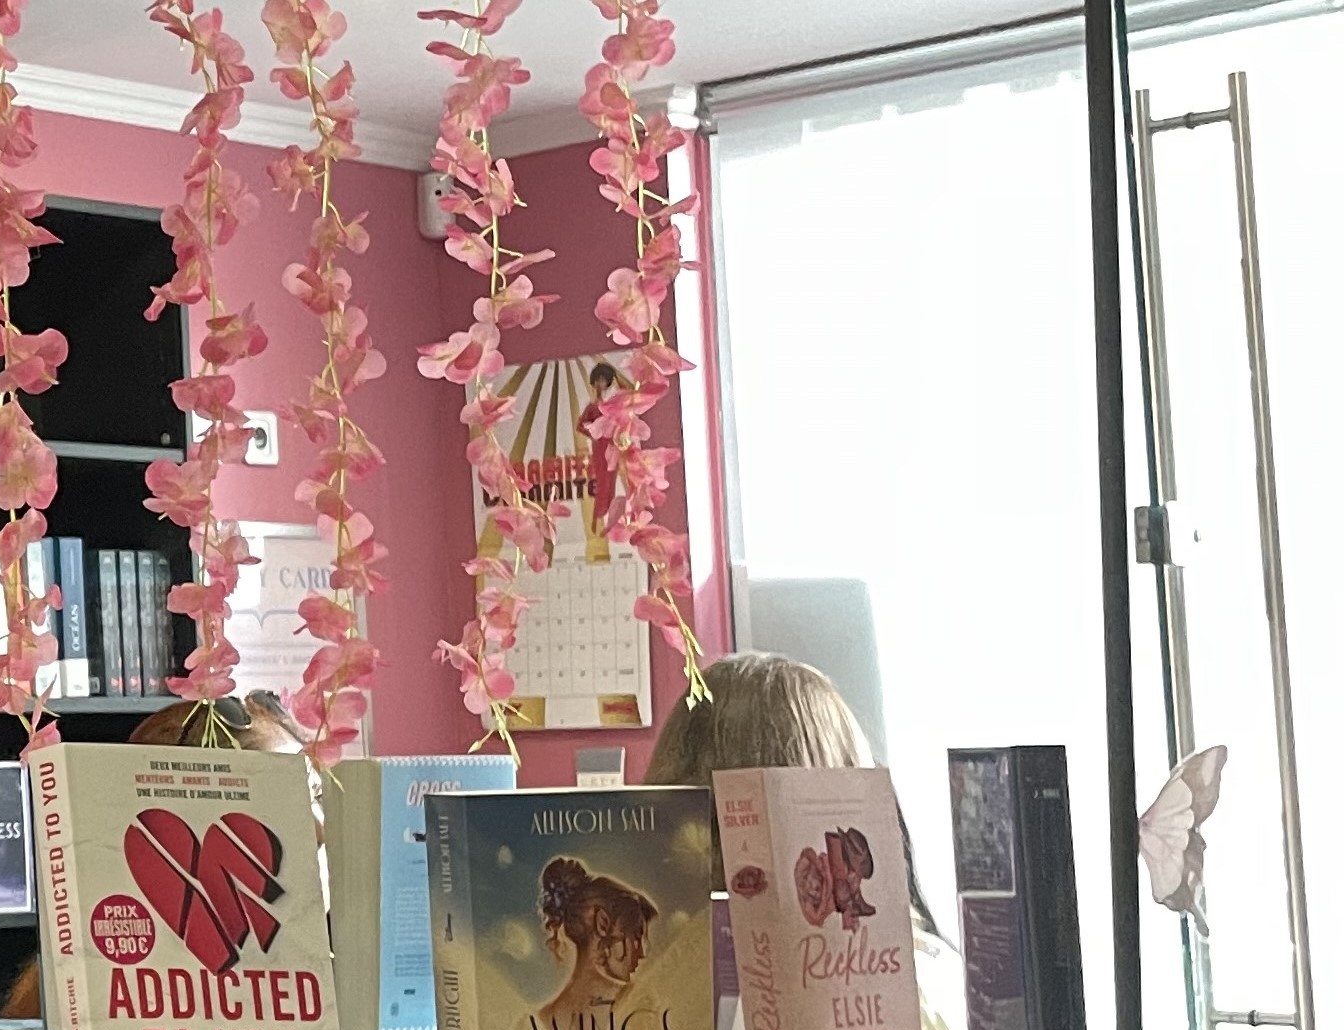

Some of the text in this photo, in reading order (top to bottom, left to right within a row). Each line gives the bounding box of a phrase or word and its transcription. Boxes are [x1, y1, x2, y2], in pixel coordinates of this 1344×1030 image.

[531, 809, 611, 835] ALLISON
[724, 814, 759, 828] SILVER
[725, 800, 753, 813] ELSIE
[39, 761, 75, 956] ADDICTED TO YOU
[103, 905, 139, 918] PRIX
[800, 927, 901, 990] Reckless
[66, 976, 78, 1024] RITCHIE
[108, 967, 321, 1022] ADDICTED
[832, 994, 884, 1029] ELSIE
